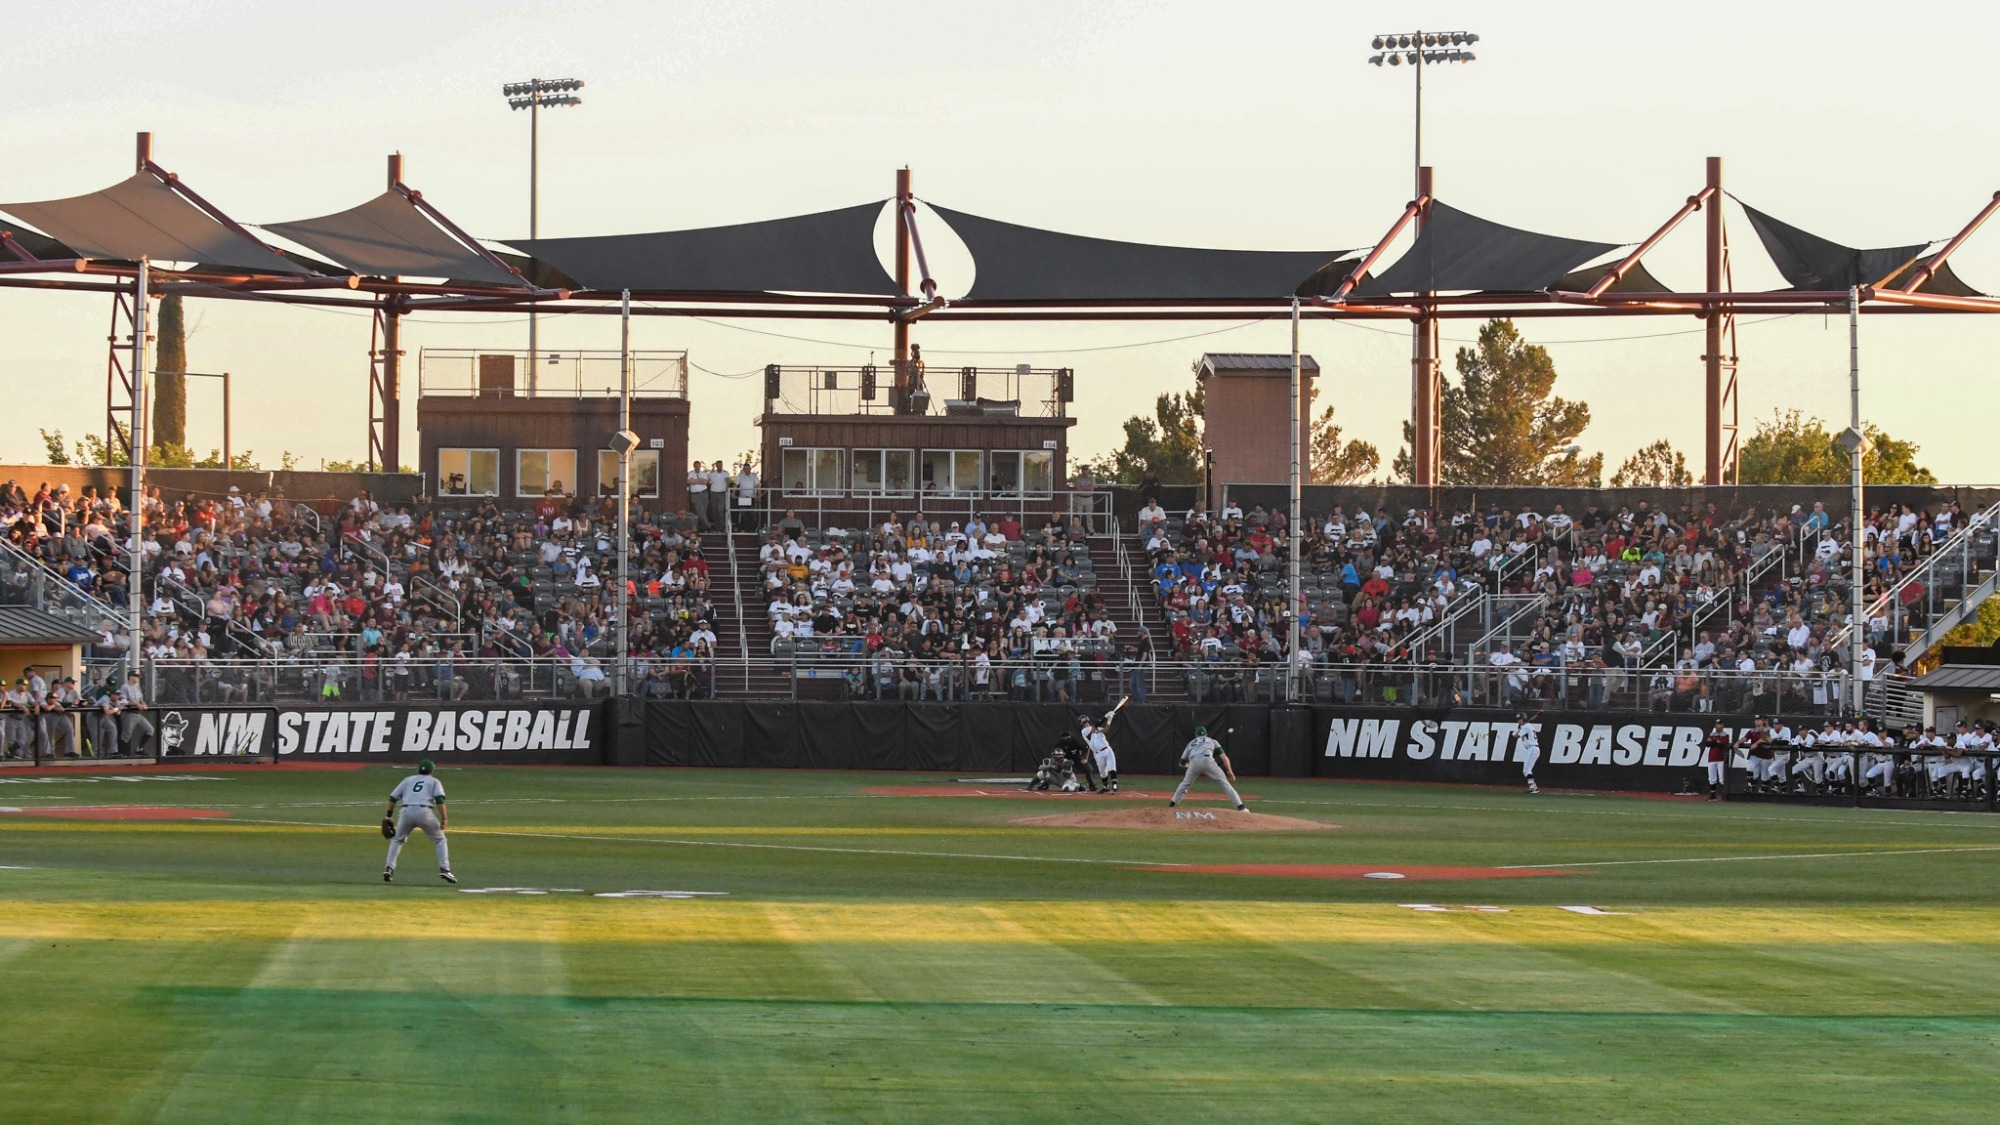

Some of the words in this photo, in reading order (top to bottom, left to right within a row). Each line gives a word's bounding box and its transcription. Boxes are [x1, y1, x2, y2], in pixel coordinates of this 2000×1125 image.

[542, 506, 555, 516] NM
[194, 712, 267, 755] NM
[278, 711, 395, 755] STATE
[401, 709, 591, 753] BASEBALL
[1325, 718, 1400, 758] NM
[412, 780, 425, 792] 6
